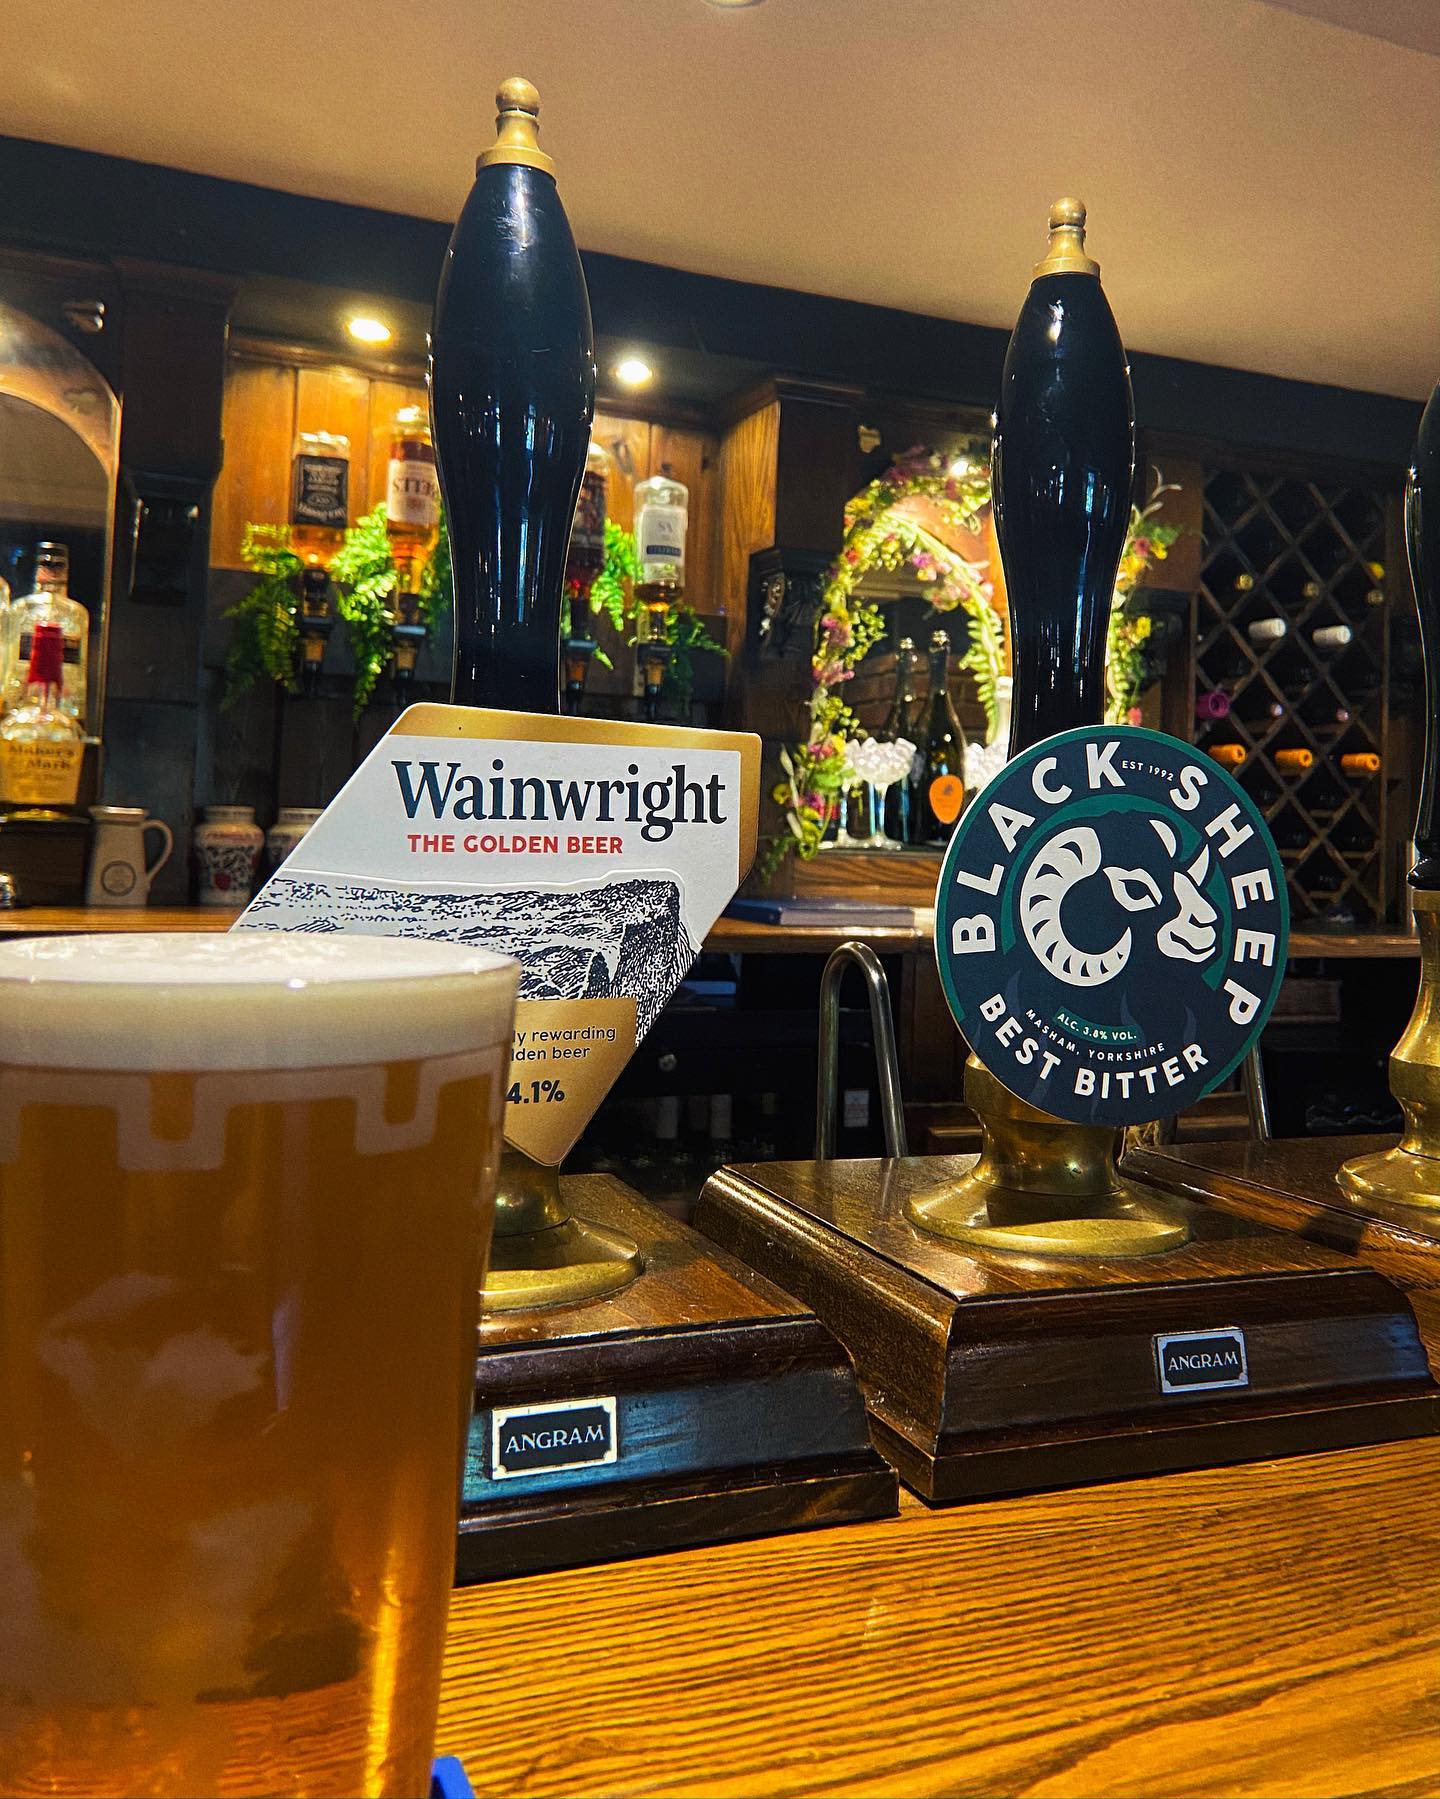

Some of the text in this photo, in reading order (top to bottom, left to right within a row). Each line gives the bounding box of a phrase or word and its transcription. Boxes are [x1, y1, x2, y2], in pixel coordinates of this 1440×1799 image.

[1122, 760, 1174, 781] EST 1992
[391, 758, 727, 843] Wainwright
[407, 834, 623, 854] THE GOLDEN BEER
[952, 741, 1276, 1025] BLACK SHEEP
[532, 1026, 616, 1042] rewarding
[1025, 1009, 1165, 1062] MASHAM, YORKSHIRE
[1056, 1012, 1137, 1041] ALC. 3.8% VOL.
[552, 1046, 591, 1060] beer
[979, 993, 1209, 1099] BEST BITTER
[505, 1079, 566, 1105] 4.1%
[1167, 1350, 1239, 1372] ANGRAM
[504, 1423, 605, 1454] ANGRAM
